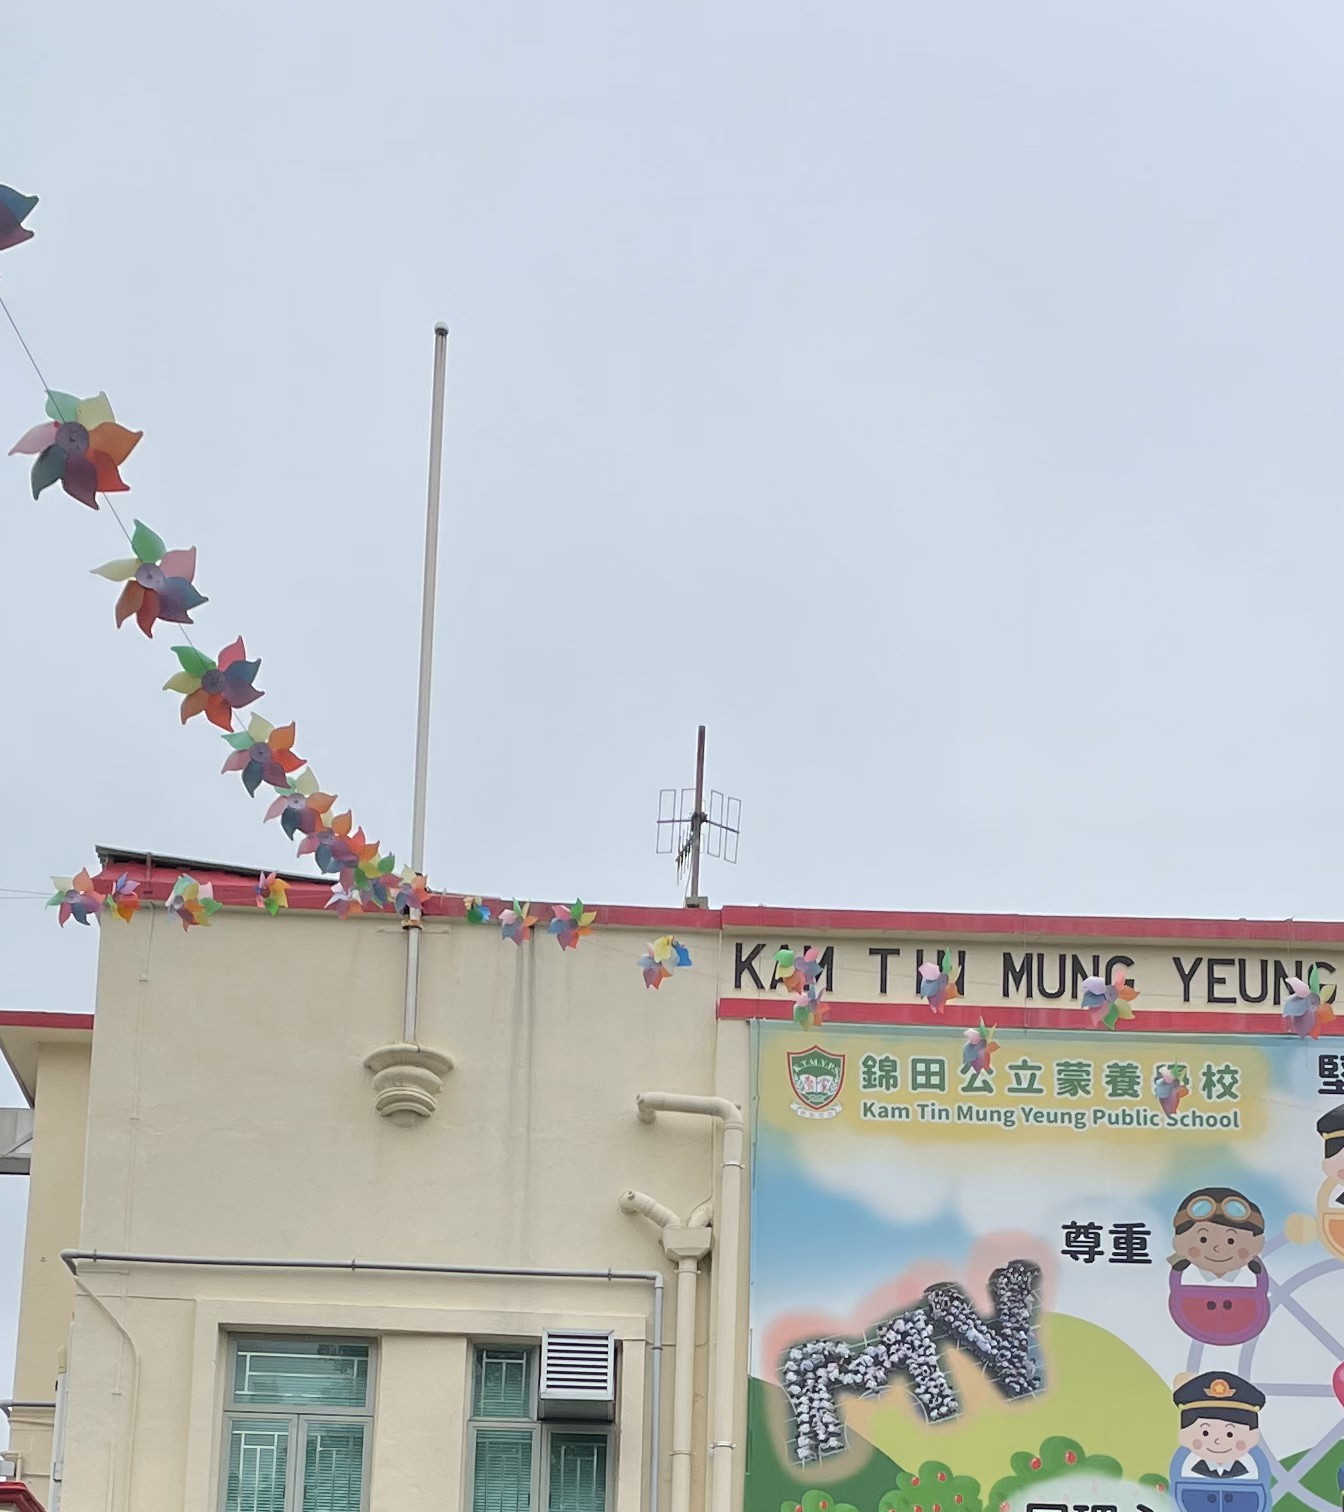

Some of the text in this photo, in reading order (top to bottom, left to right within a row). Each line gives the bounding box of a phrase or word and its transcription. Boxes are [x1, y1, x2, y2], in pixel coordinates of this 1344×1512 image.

[861, 1102, 910, 1120] Kam
[916, 1103, 950, 1121] Tin
[956, 1105, 1016, 1127] Mung
[1021, 1106, 1087, 1129] Yeung
[1093, 1108, 1160, 1127] Public
[1060, 1221, 1152, 1264] 尊重
